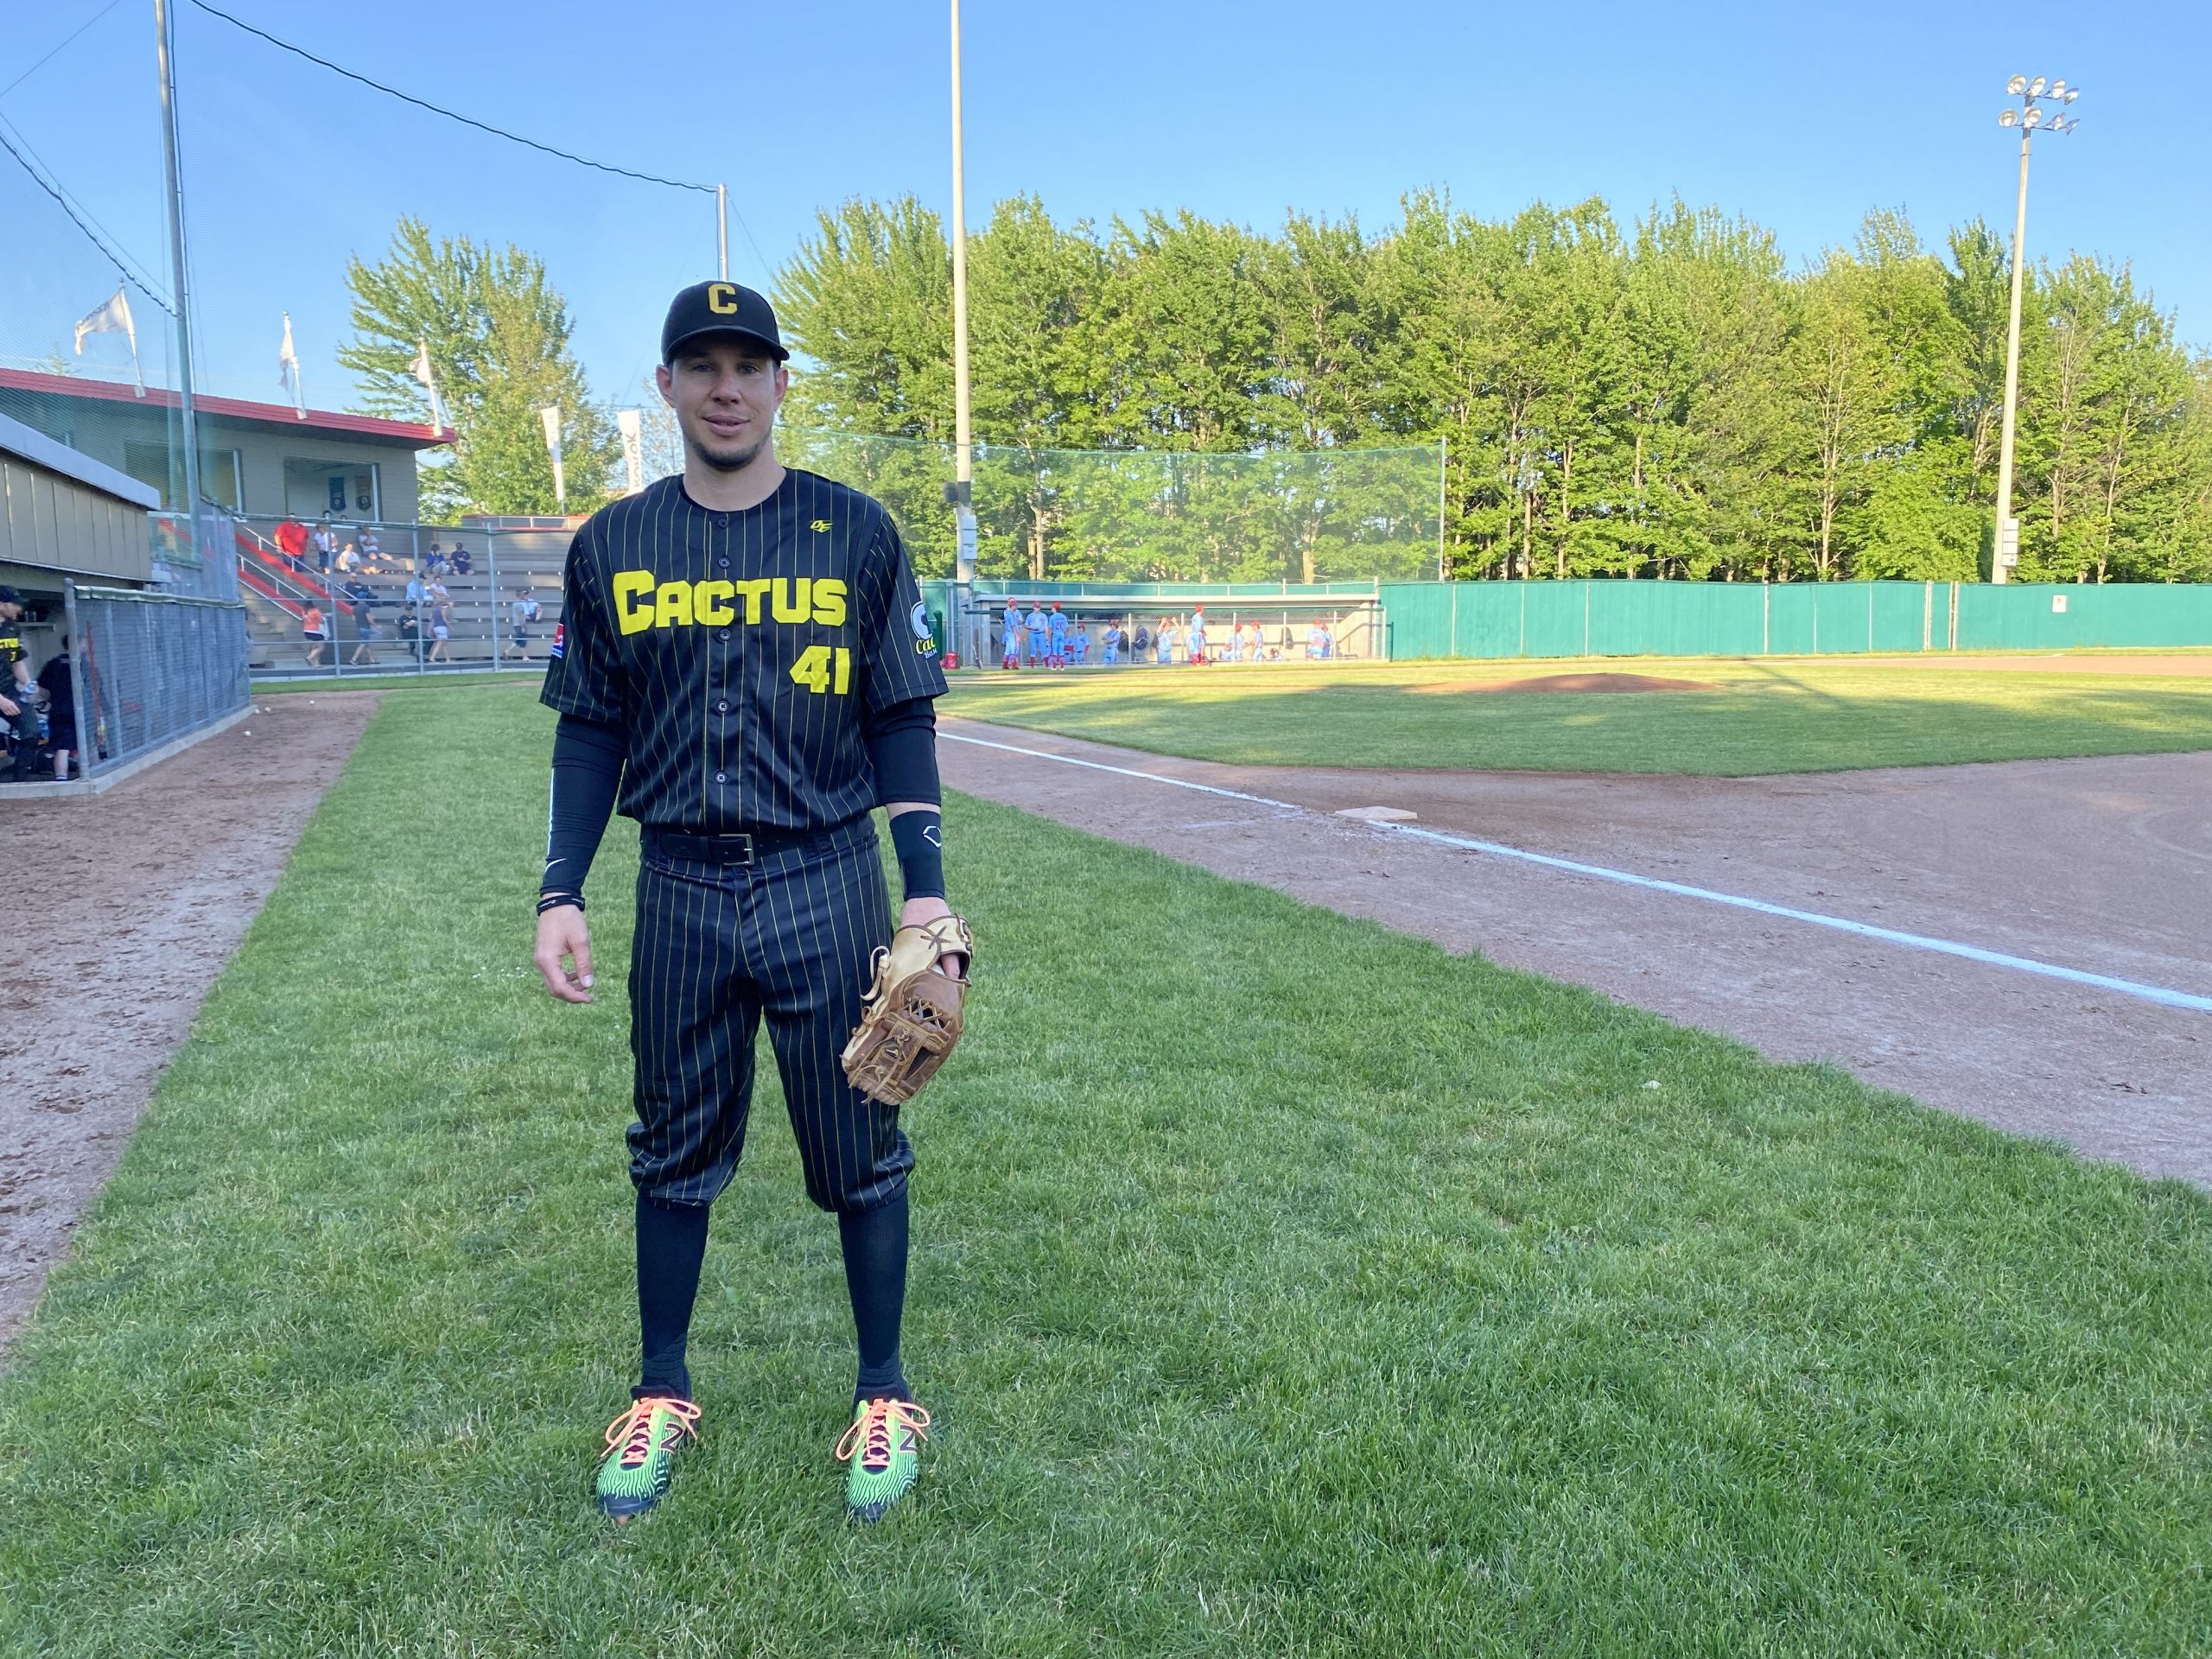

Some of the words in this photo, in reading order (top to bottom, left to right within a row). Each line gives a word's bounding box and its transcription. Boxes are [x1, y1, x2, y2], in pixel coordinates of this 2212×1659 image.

[709, 283, 738, 314] C
[613, 569, 848, 635] CACTUS
[789, 645, 849, 695] 41
